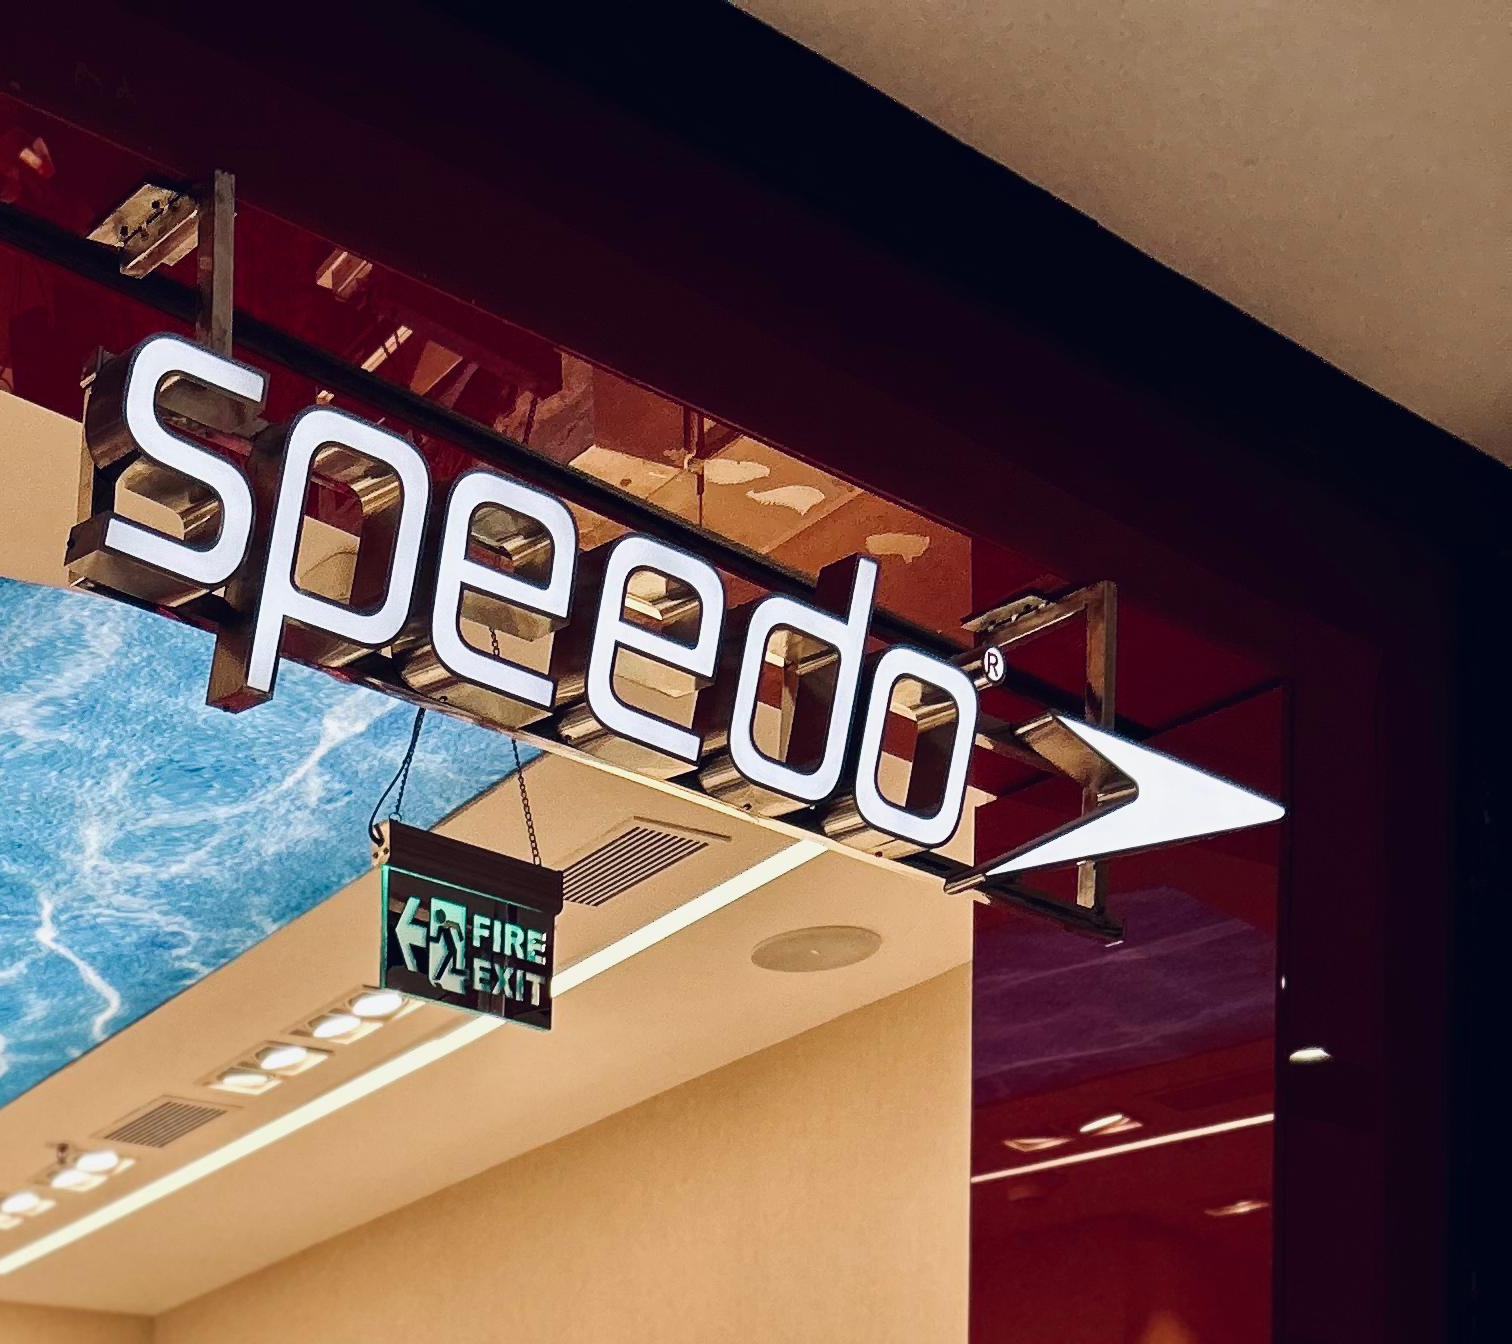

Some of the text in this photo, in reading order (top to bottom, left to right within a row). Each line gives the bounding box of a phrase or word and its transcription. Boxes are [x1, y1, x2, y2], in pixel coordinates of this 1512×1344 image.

[103, 334, 980, 850] speedo
[472, 914, 547, 966] FIRE
[473, 957, 546, 1006] EXIT
